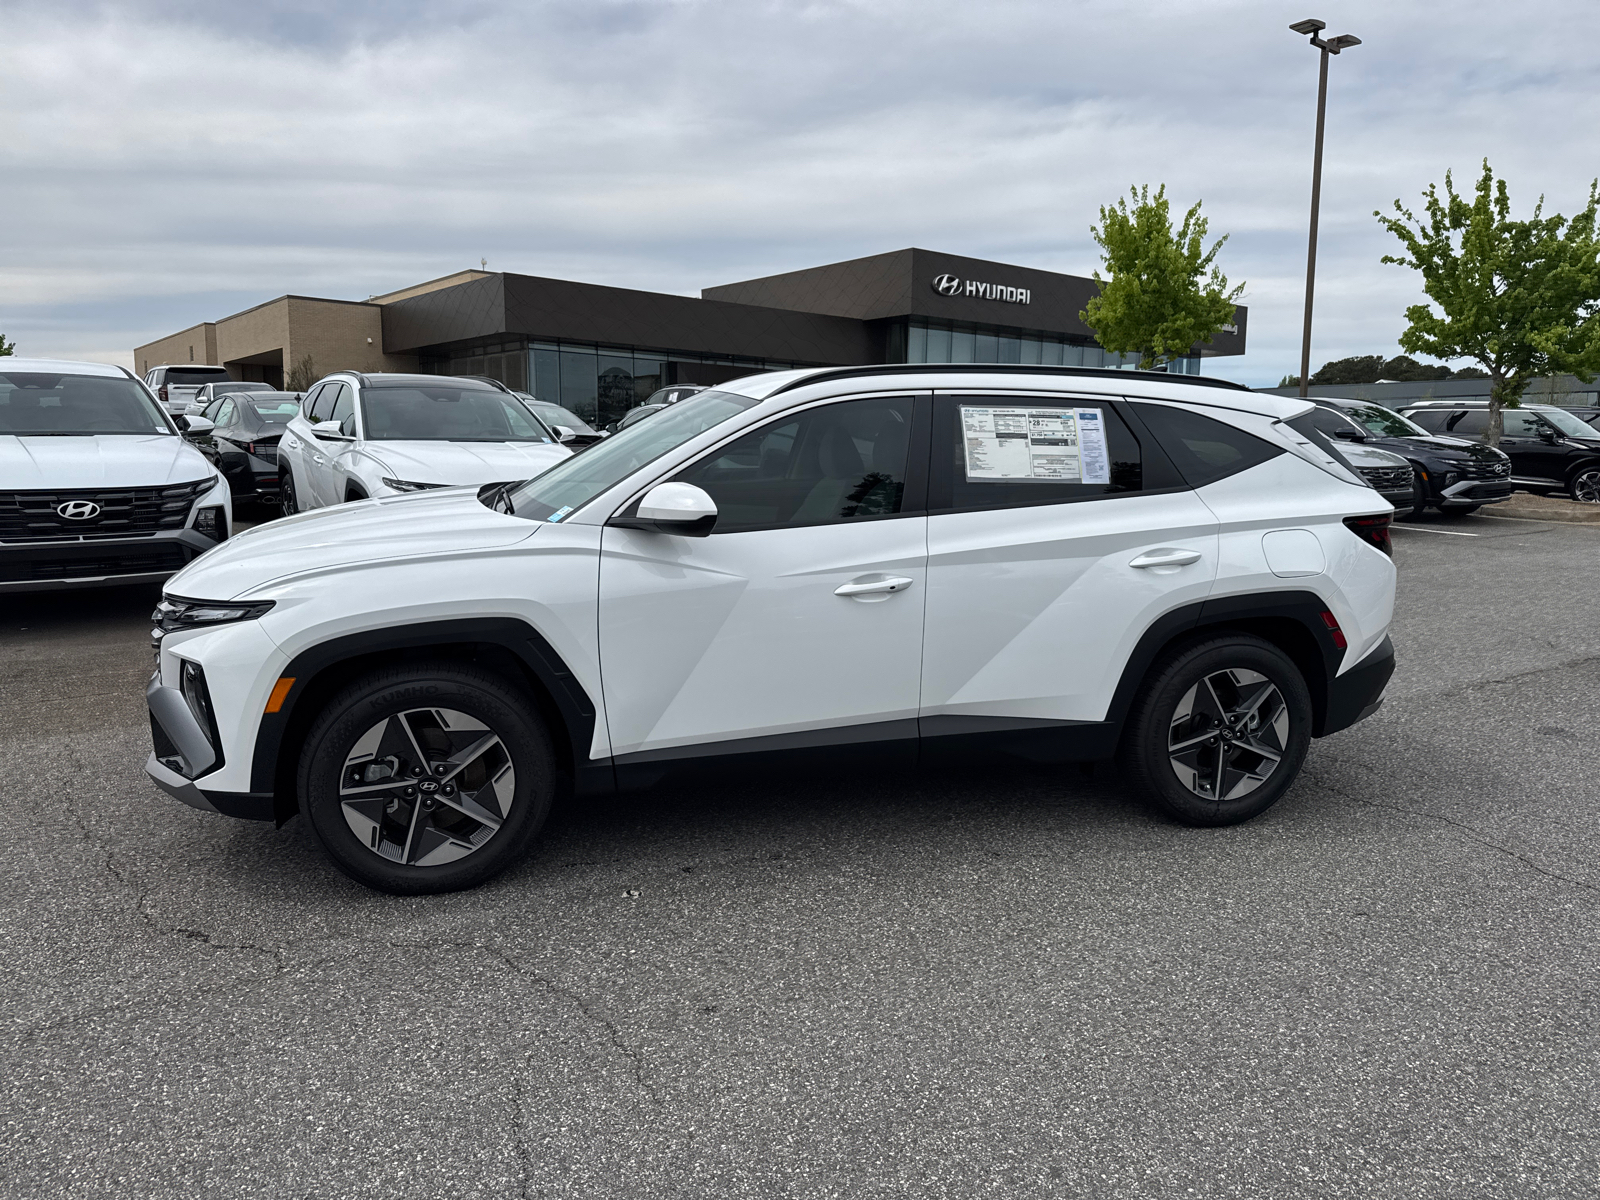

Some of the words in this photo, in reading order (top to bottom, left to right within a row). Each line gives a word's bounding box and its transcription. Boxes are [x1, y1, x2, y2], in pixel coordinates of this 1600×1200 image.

[966, 280, 1031, 304] HYUNDAI
[1033, 419, 1040, 427] 28
[369, 685, 438, 708] KUMHO
